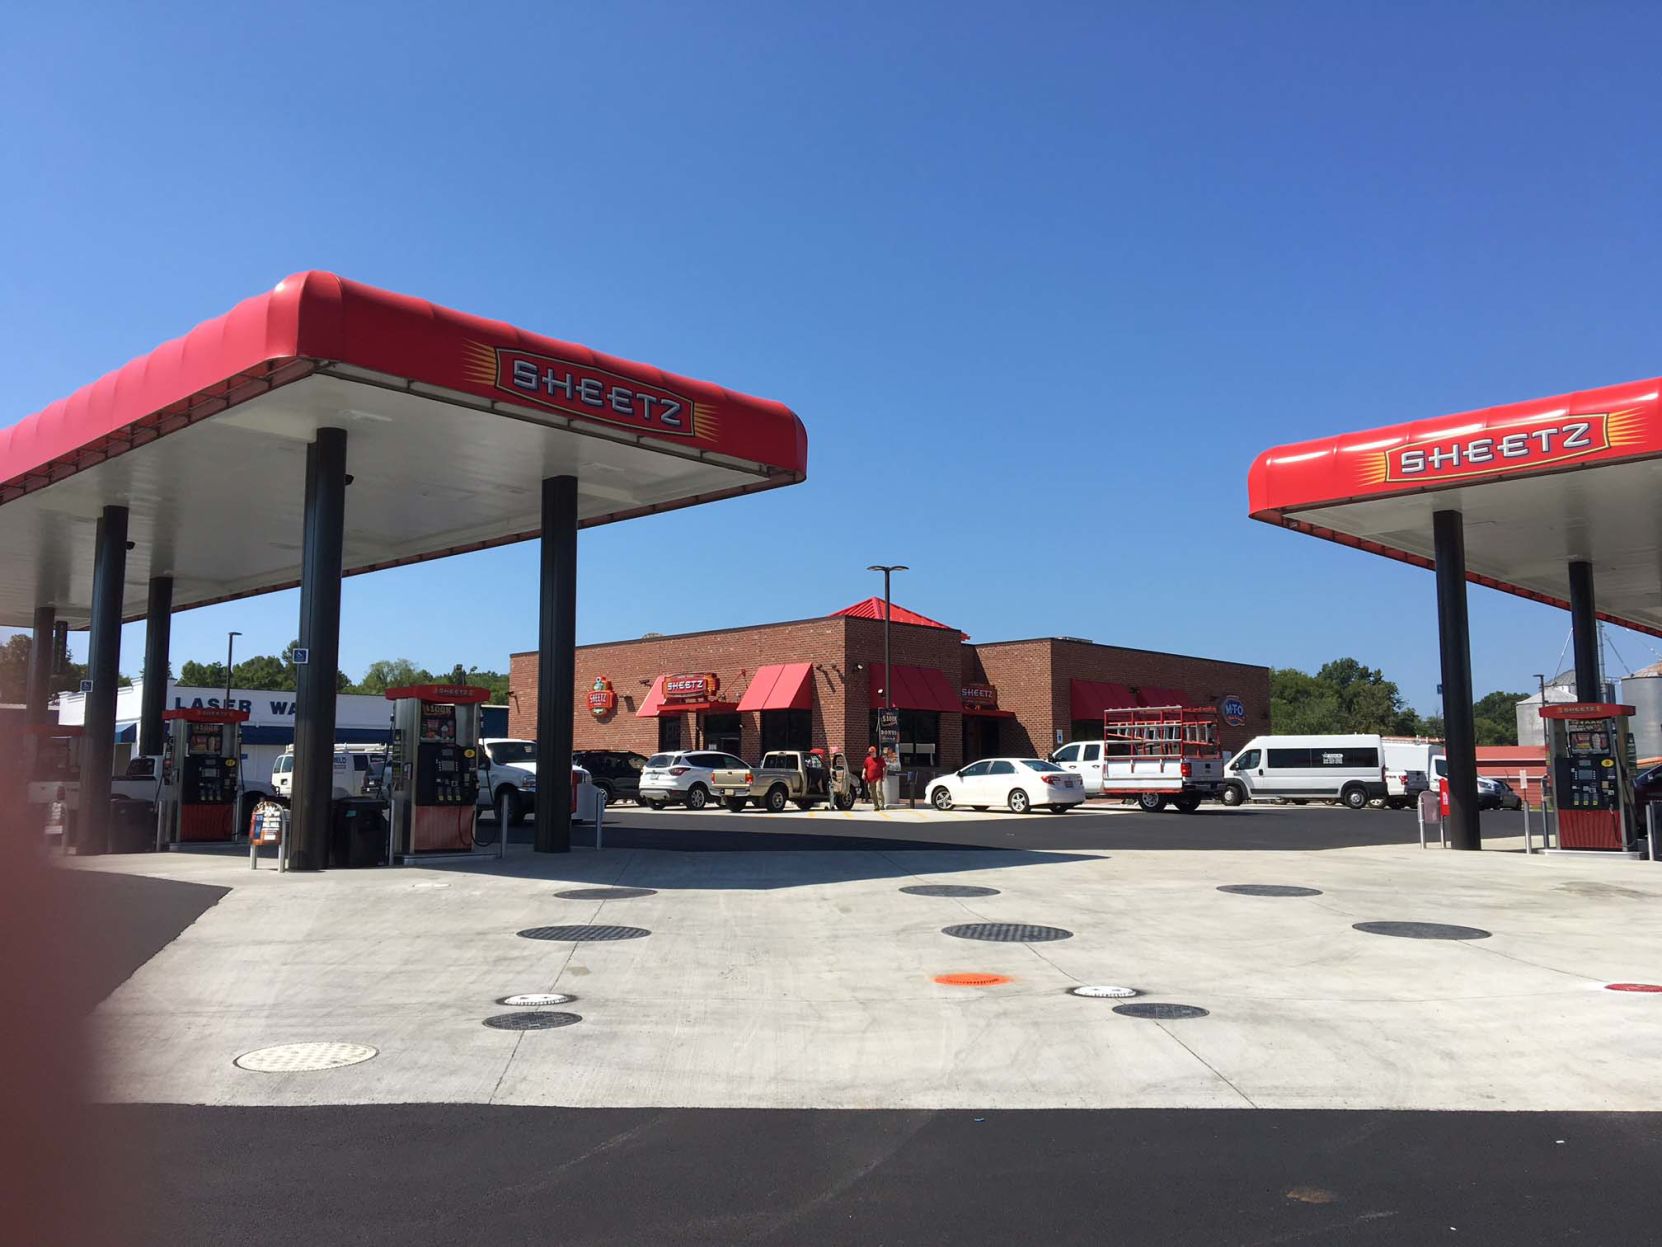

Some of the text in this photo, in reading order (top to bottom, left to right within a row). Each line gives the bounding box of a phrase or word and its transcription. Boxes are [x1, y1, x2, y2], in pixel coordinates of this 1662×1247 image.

[513, 360, 681, 427] SHEETZ
[1401, 422, 1591, 474] SHEETZ
[667, 679, 703, 691] SHEETZ
[961, 688, 993, 698] SHEETZ
[175, 697, 252, 713] LASER
